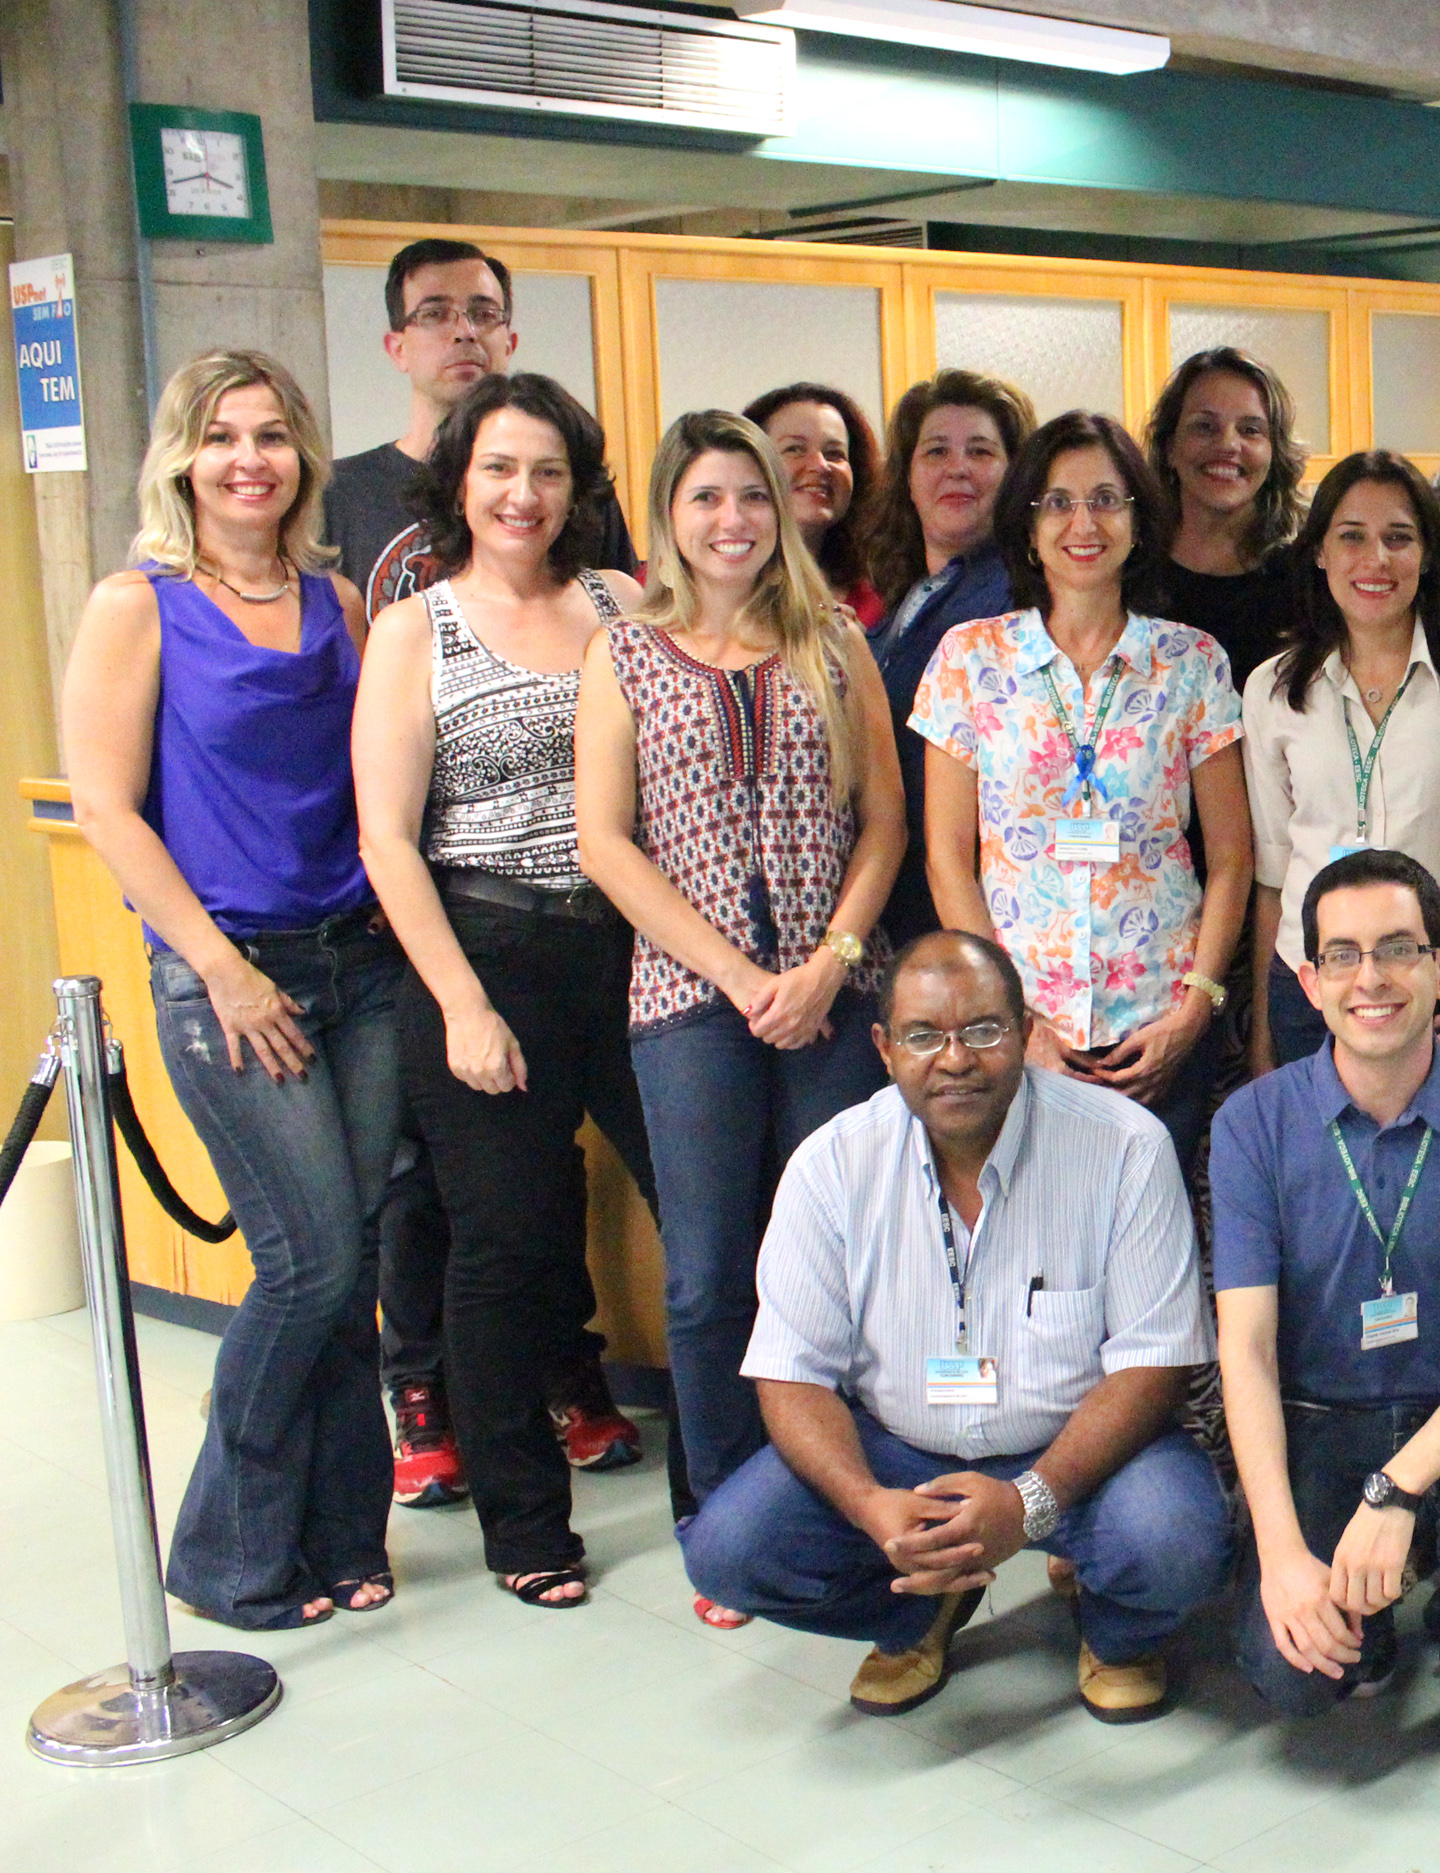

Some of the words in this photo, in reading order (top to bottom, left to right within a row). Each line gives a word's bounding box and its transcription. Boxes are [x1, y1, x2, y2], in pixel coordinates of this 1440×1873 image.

[20, 339, 62, 369] AQUI
[40, 375, 76, 403] TEM
[1354, 764, 1362, 784] EESC
[1364, 756, 1375, 775] EESC
[1336, 1139, 1358, 1181] BIBLIOTECA
[1407, 1168, 1420, 1188] EESC
[1355, 1188, 1369, 1209] EESC
[941, 1213, 951, 1233] EESC
[1391, 1196, 1411, 1237] BIBLIOTECA
[946, 1247, 956, 1268] EESC
